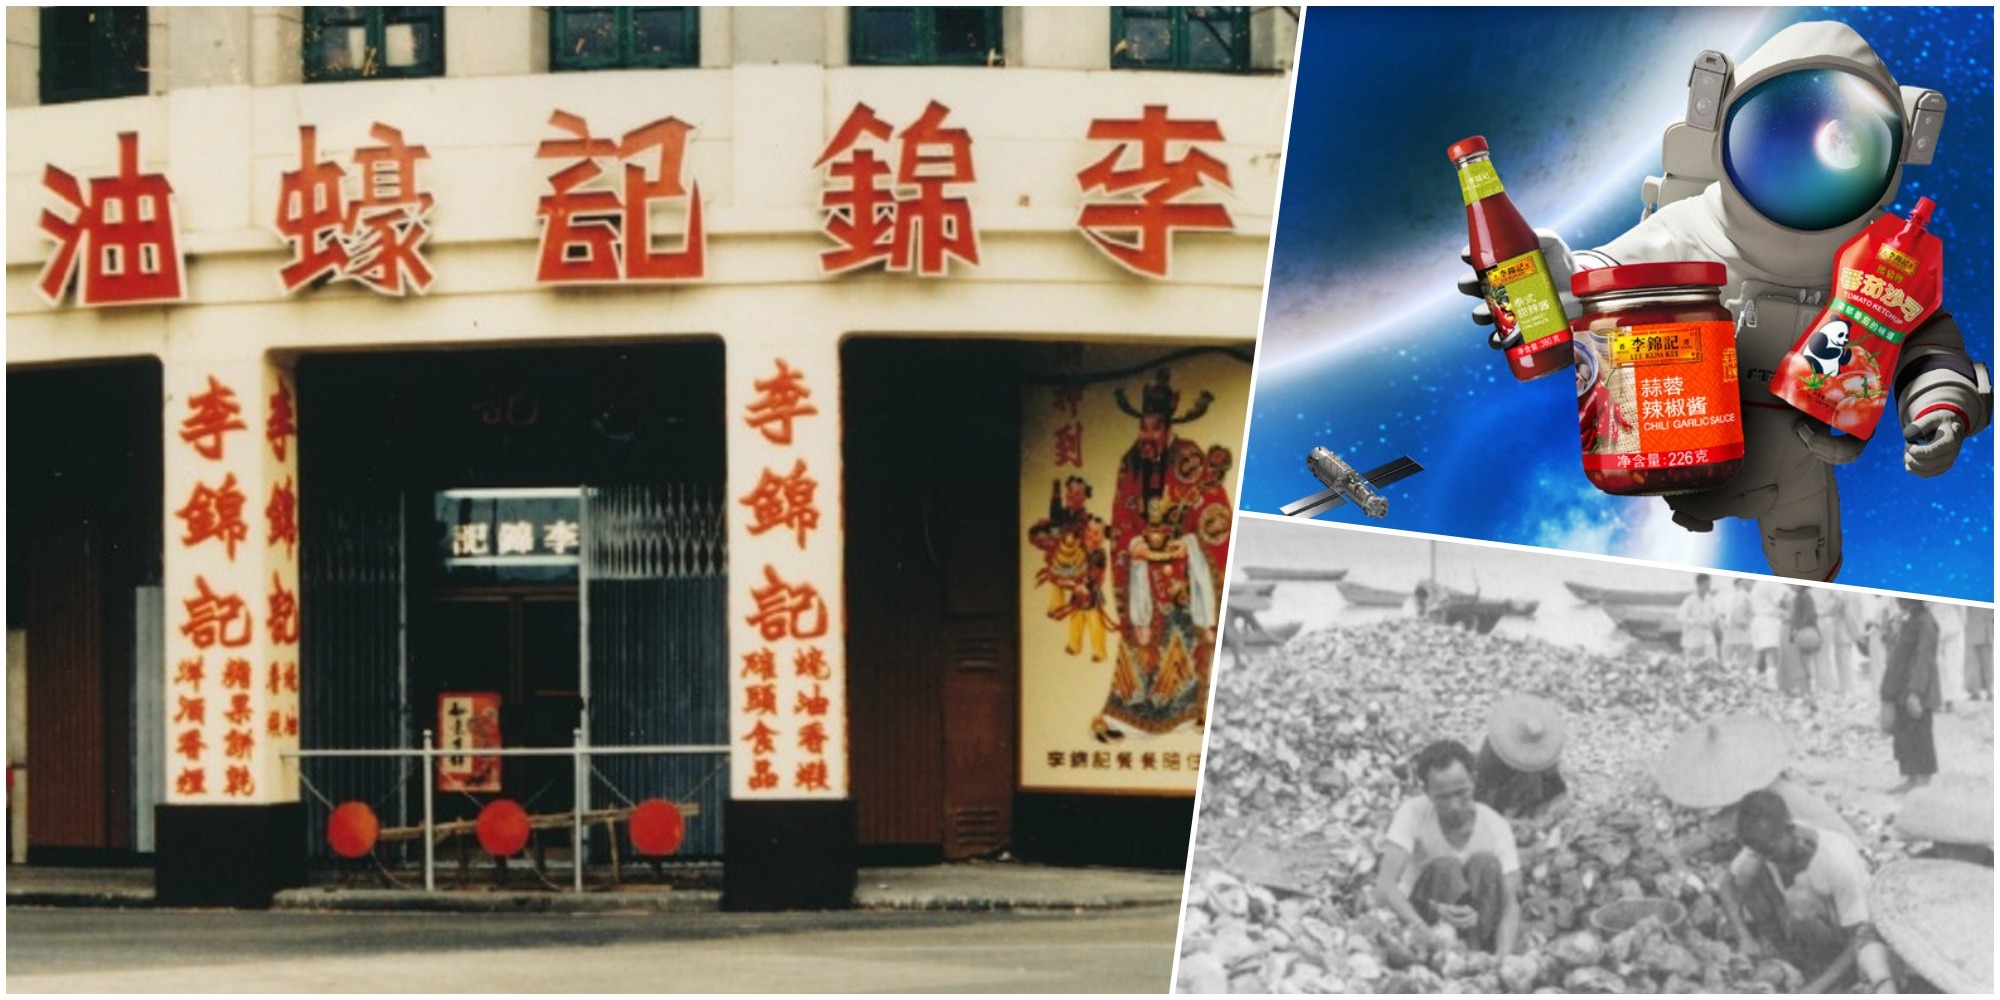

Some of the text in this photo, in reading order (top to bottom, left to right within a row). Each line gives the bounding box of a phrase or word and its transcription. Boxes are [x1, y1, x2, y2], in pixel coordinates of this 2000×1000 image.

[1841, 267, 1924, 322] 番茄沙司
[1844, 291, 1904, 325] TOMATO KETCHUP
[1630, 335, 1679, 352] 李錦記
[1630, 353, 1642, 361] LEE
[1645, 351, 1663, 360] KUM
[1665, 350, 1679, 358] KEE
[1641, 375, 1684, 398] 蒜蓉
[1642, 396, 1707, 420] 辣椒酱
[1643, 413, 1736, 432] CHILI GARLIC SAUCE
[174, 374, 253, 648] 李錦記
[265, 373, 299, 646] 李錦記
[740, 357, 829, 641] 李錦記
